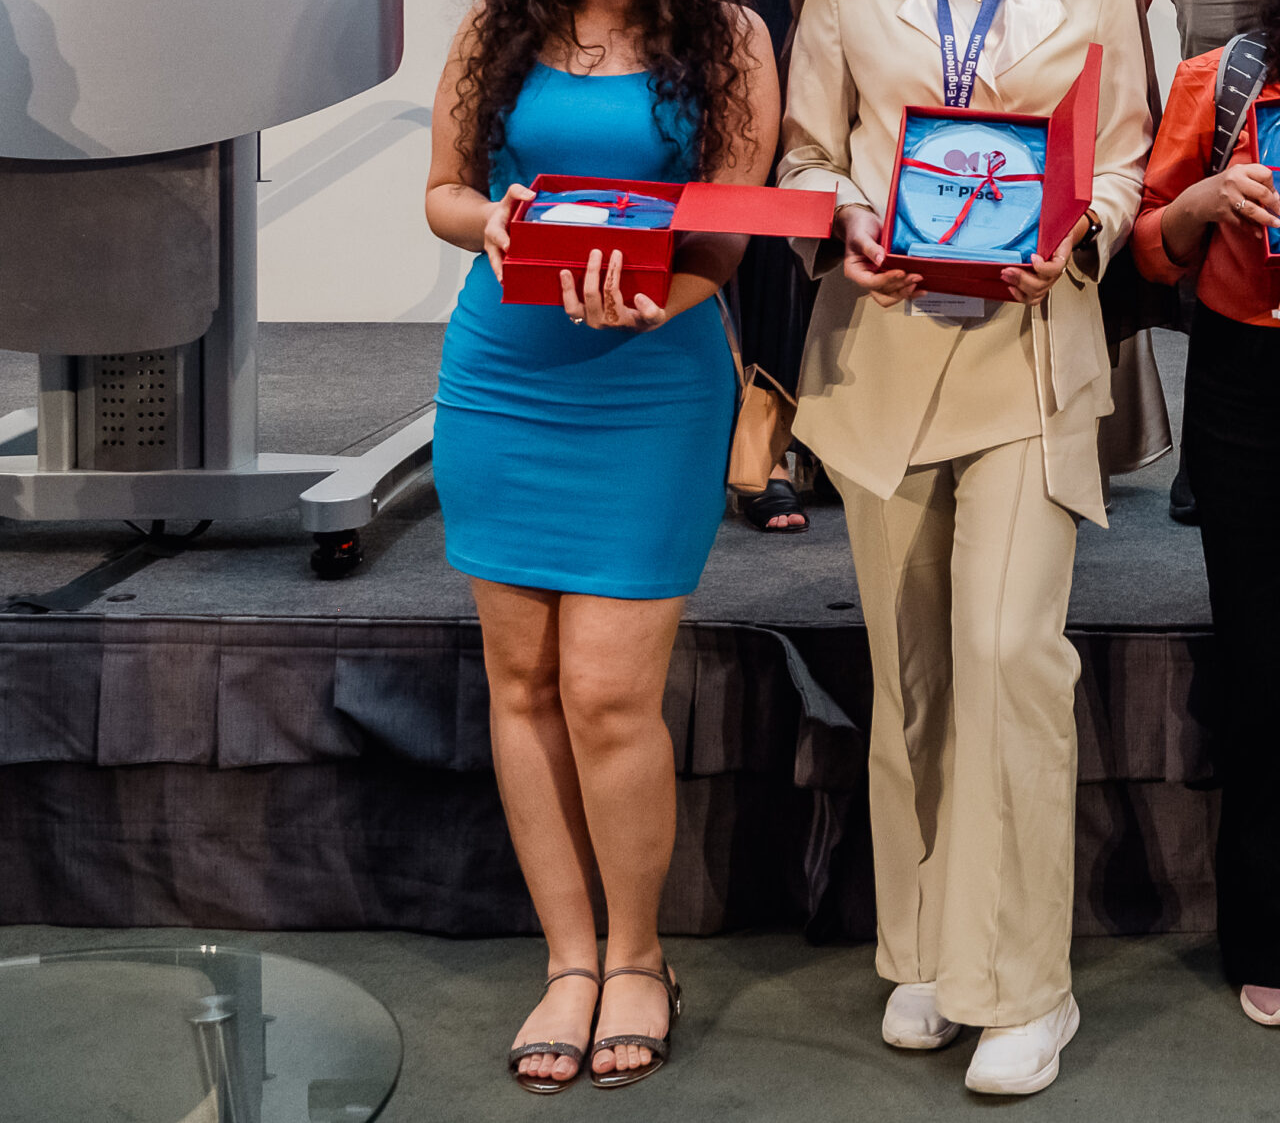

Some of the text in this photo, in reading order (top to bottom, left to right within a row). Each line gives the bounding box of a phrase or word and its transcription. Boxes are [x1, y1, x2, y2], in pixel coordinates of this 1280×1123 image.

[943, 34, 959, 98] Engineering
[958, 60, 977, 108] Engineer
[938, 184, 954, 196] 1st
